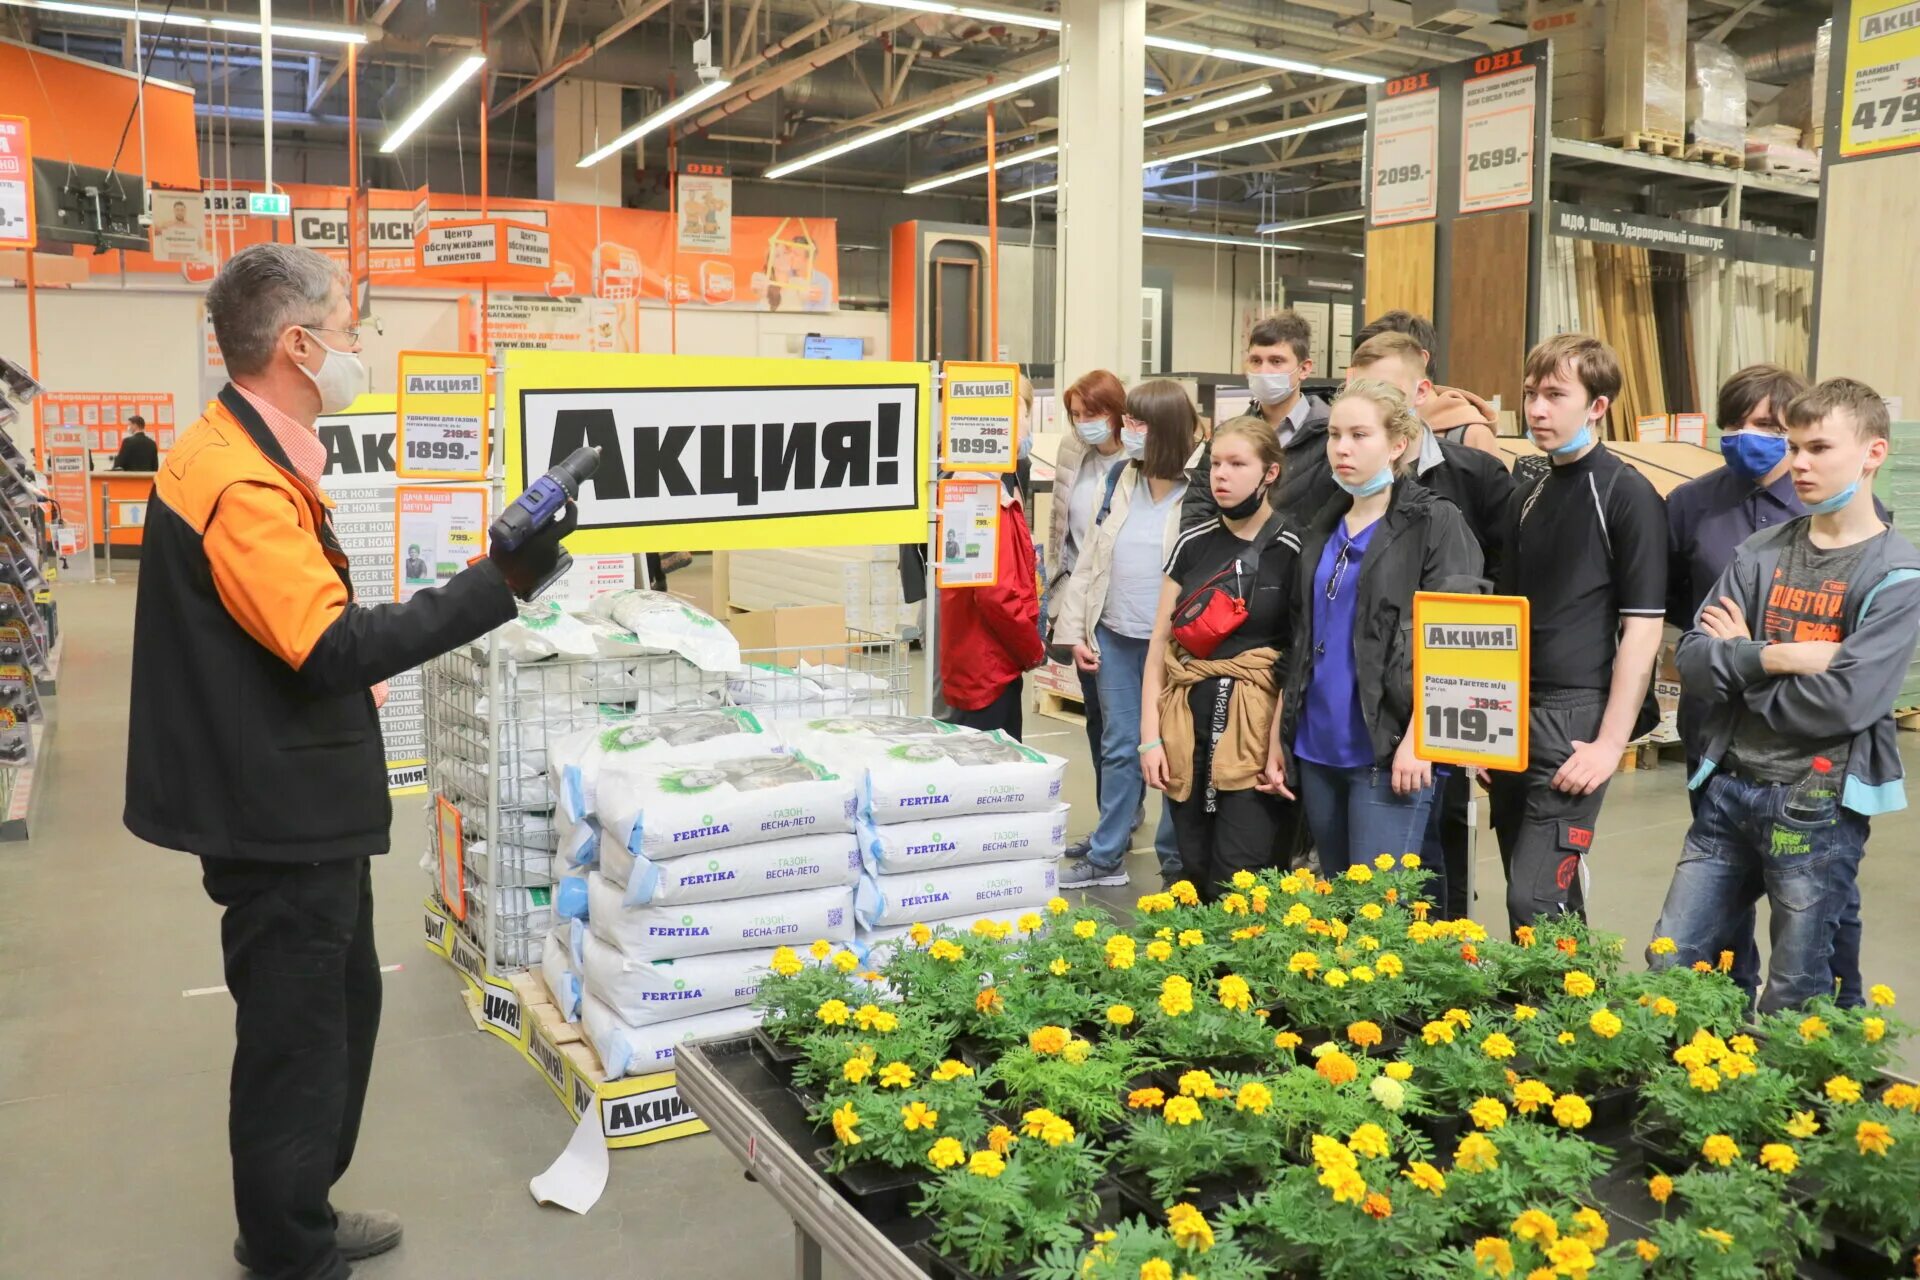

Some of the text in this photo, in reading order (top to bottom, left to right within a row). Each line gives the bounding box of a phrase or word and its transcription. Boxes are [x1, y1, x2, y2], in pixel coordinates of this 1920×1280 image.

[1864, 8, 1920, 38] Акц
[1474, 49, 1523, 73] OBI
[1856, 63, 1900, 78] ЛАМИНАТ
[1386, 73, 1429, 96] OBI
[1468, 147, 1529, 171] 2699.-
[687, 163, 724, 175] OBI
[1377, 164, 1431, 186] 2099.-
[1560, 213, 1586, 232] МДФ,
[1590, 217, 1618, 235] Шпон,
[1621, 222, 1687, 244] Ударопрочный
[444, 230, 473, 240] Центр
[520, 231, 537, 242] Центр
[424, 240, 494, 252] обслуживания
[508, 242, 549, 254] обслуживания
[437, 253, 481, 262] клиентов
[516, 254, 542, 264] клиентов
[410, 377, 478, 392] Акция!
[953, 383, 1009, 396] Акция!
[406, 441, 478, 460] 1899.-
[951, 438, 1008, 454] 1899.-
[549, 403, 901, 506] Акция!
[351, 489, 379, 498] HOME
[403, 493, 423, 501] ДАЧА
[352, 504, 381, 513] HOME
[369, 522, 393, 532] HOM
[340, 538, 366, 548] GGER
[349, 556, 379, 566] GGER
[351, 571, 379, 581] GGER
[1429, 627, 1513, 648] Акция!
[388, 675, 418, 686] HOME
[1425, 675, 1506, 691] Рассада Тагетес м/ц
[388, 690, 419, 701] HOME
[389, 705, 420, 716] HOME
[390, 721, 420, 731] HOME
[1426, 705, 1513, 743] 119.-
[391, 736, 421, 746] HOME
[388, 767, 426, 785] кция!
[989, 785, 1015, 794] ГАЗОН
[900, 795, 949, 807] FERTIKA
[976, 794, 1025, 805] ВЕСНА-ЛЕТО
[773, 807, 803, 819] ГАЗОН
[761, 816, 815, 831] ВЕСНА-ЛЕТО
[673, 824, 730, 842] FERTIKA
[993, 831, 1019, 841] ГАЗОН
[906, 842, 956, 855] FERTIKA
[982, 840, 1029, 851] ВЕСНА-ЛЕТО
[778, 856, 807, 867] ГАЗОН
[680, 870, 735, 886] FERTIKA
[766, 865, 820, 879] ВЕСНА-ЛЕТО
[986, 879, 1012, 889] ГАЗОН
[976, 886, 1023, 900] ВЕСНА-ЛЕТО
[901, 892, 950, 907] FERTIKA
[755, 914, 784, 925] ГАЗОН
[649, 926, 710, 936] FERTIKA
[742, 924, 798, 938] ВЕСНА-ЛЕТО
[642, 989, 703, 1001] FERTIKA
[484, 992, 520, 1030] ция!
[610, 1097, 689, 1130] Акци
